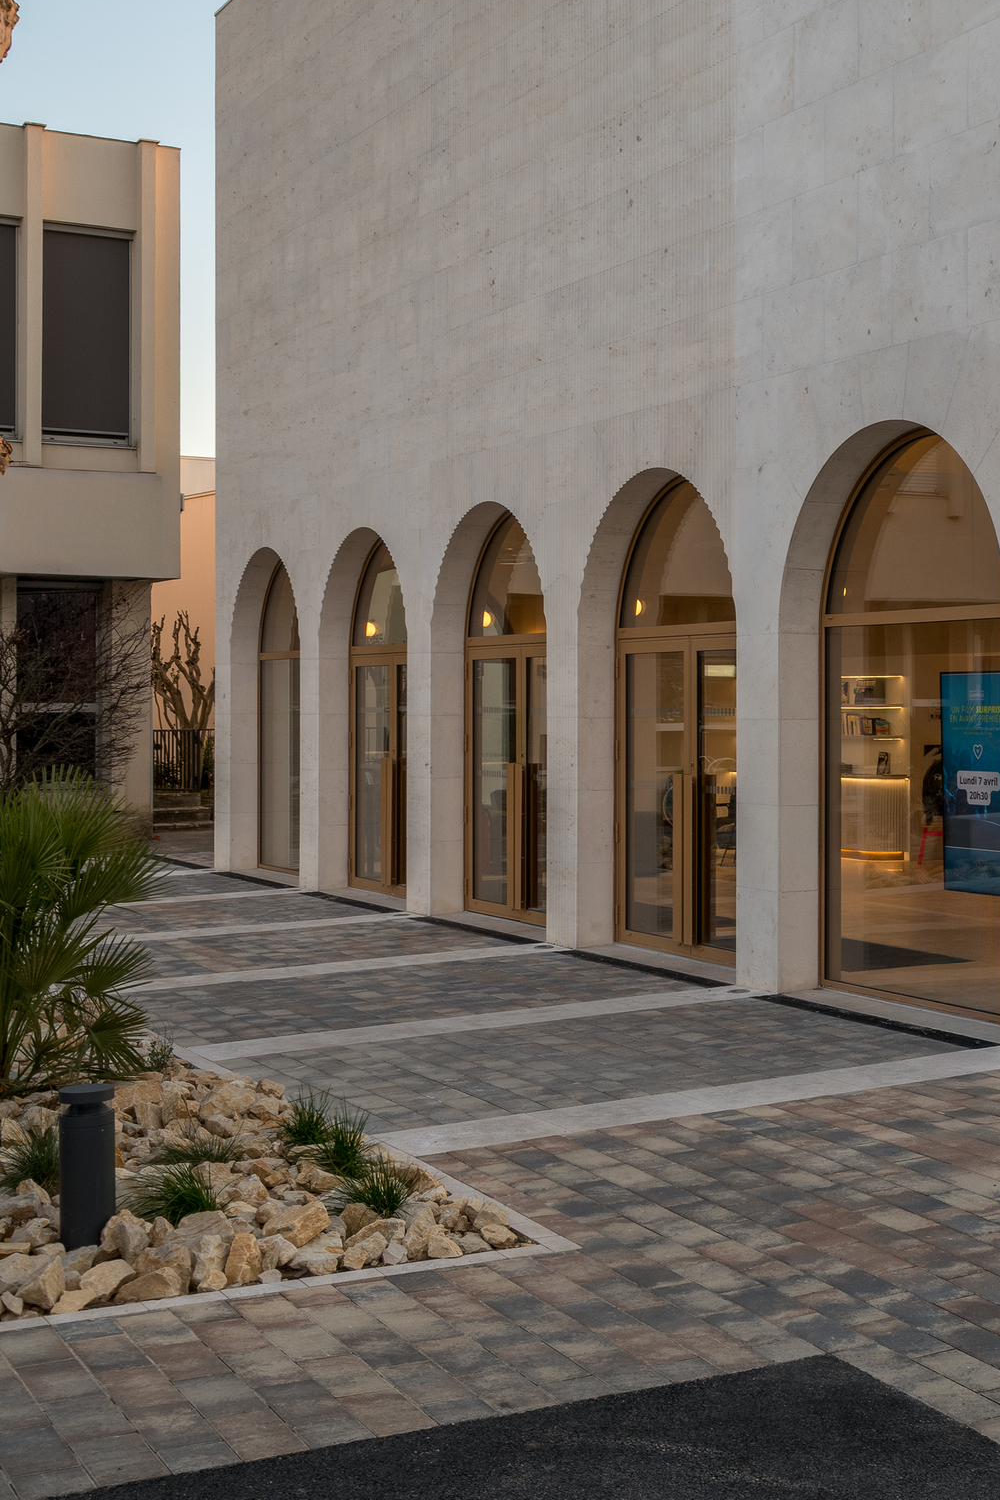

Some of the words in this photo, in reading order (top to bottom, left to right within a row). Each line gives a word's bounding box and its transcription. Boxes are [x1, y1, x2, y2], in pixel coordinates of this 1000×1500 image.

[960, 776, 977, 785] Lundi
[983, 777, 998, 786] avril
[970, 791, 989, 801] 20h30
